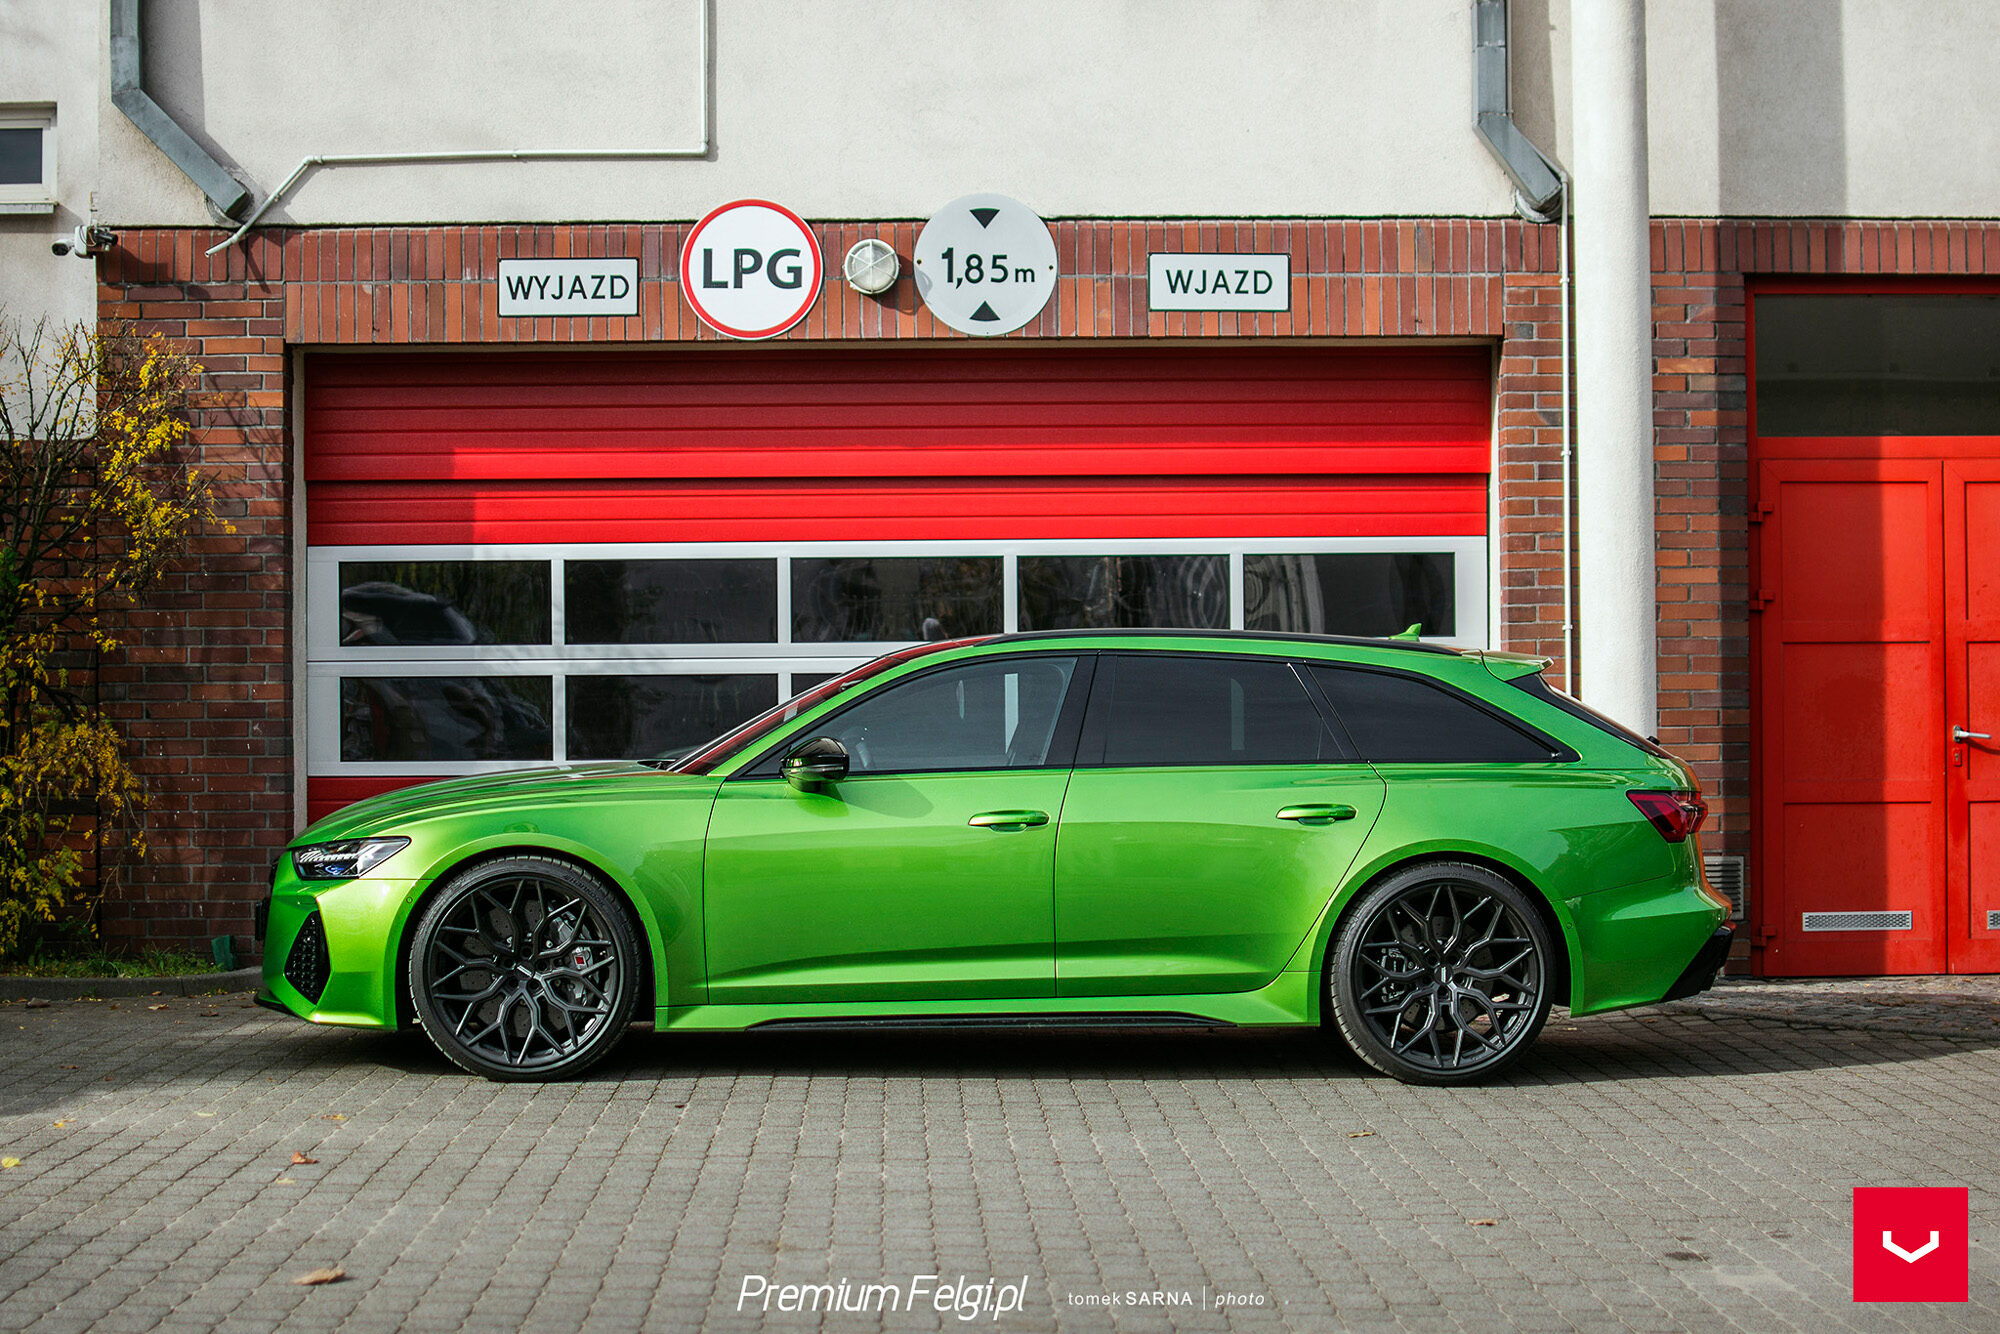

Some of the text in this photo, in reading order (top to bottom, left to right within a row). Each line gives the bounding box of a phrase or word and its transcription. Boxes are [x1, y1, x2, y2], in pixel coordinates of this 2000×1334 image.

[702, 248, 803, 290] LPG
[1165, 269, 1274, 296] WJAZD
[506, 274, 630, 301] WYJAZD
